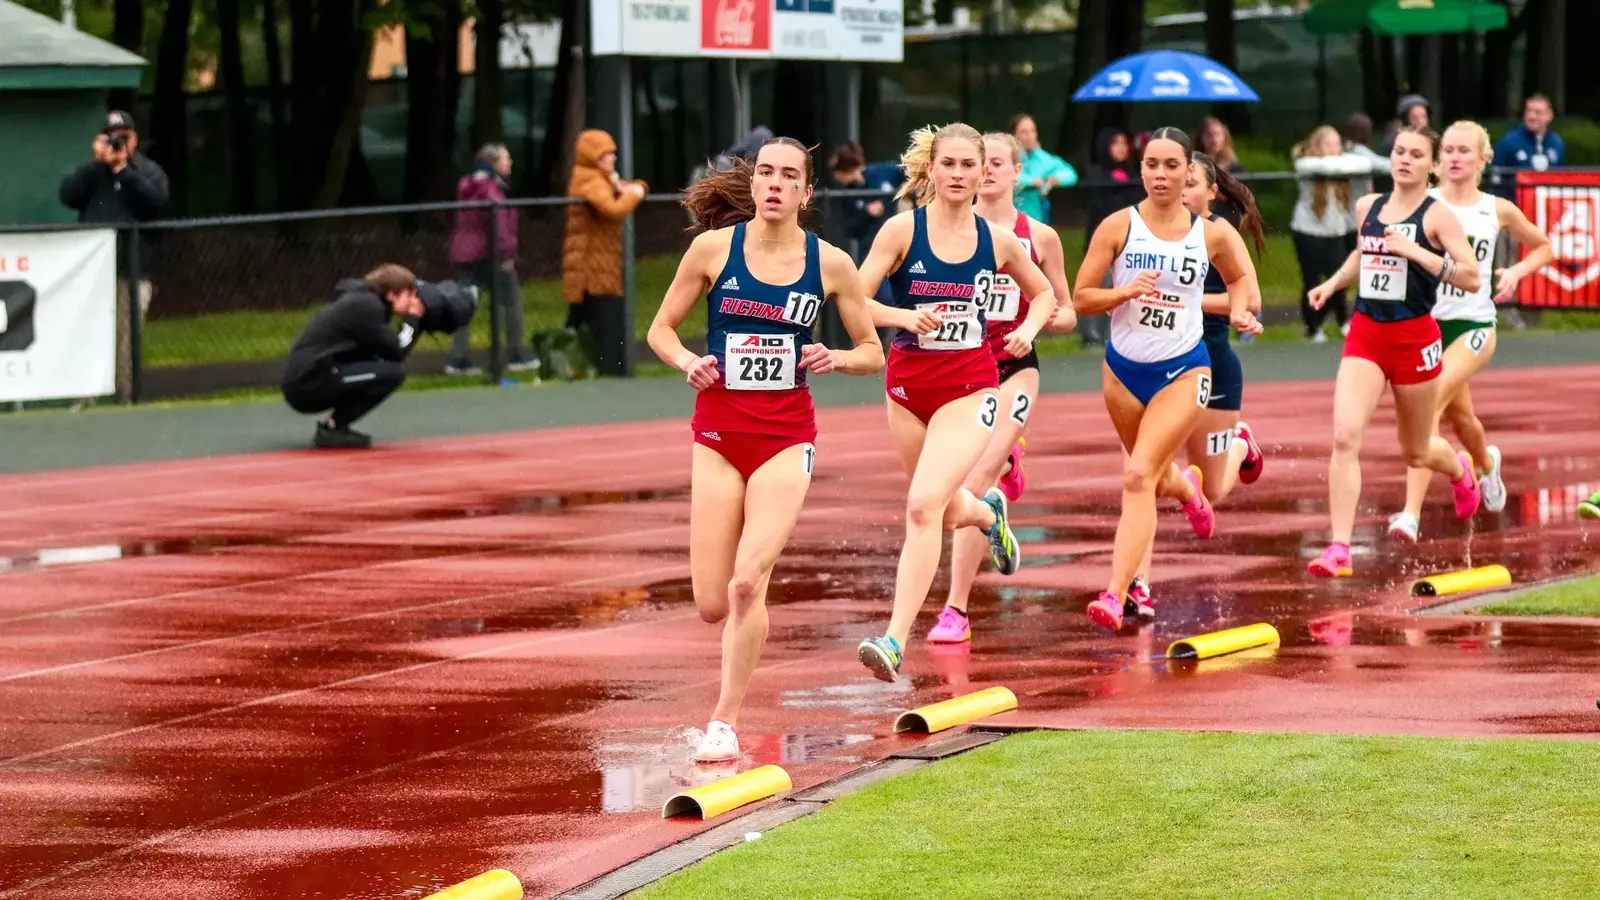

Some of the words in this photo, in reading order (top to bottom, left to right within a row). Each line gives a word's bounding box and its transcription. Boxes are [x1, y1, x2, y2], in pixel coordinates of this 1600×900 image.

[1125, 252, 1166, 270] SAINT
[1475, 239, 1490, 262] 6
[1179, 257, 1197, 285] 5
[908, 280, 975, 299] RICHMO
[975, 276, 990, 307] 3
[1371, 274, 1391, 292] 42
[719, 296, 790, 323] RICHM
[790, 294, 817, 325] 10
[986, 293, 1007, 312] 17
[1139, 306, 1176, 330] 254
[741, 335, 784, 347] A10
[934, 321, 969, 342] 227
[1470, 330, 1485, 350] 6
[1426, 344, 1440, 367] 12
[739, 356, 783, 382] 232
[1199, 377, 1210, 404] 5
[981, 397, 997, 427] 3
[1013, 394, 1029, 423] 2
[1210, 432, 1229, 454] 11
[805, 447, 816, 473] 1
